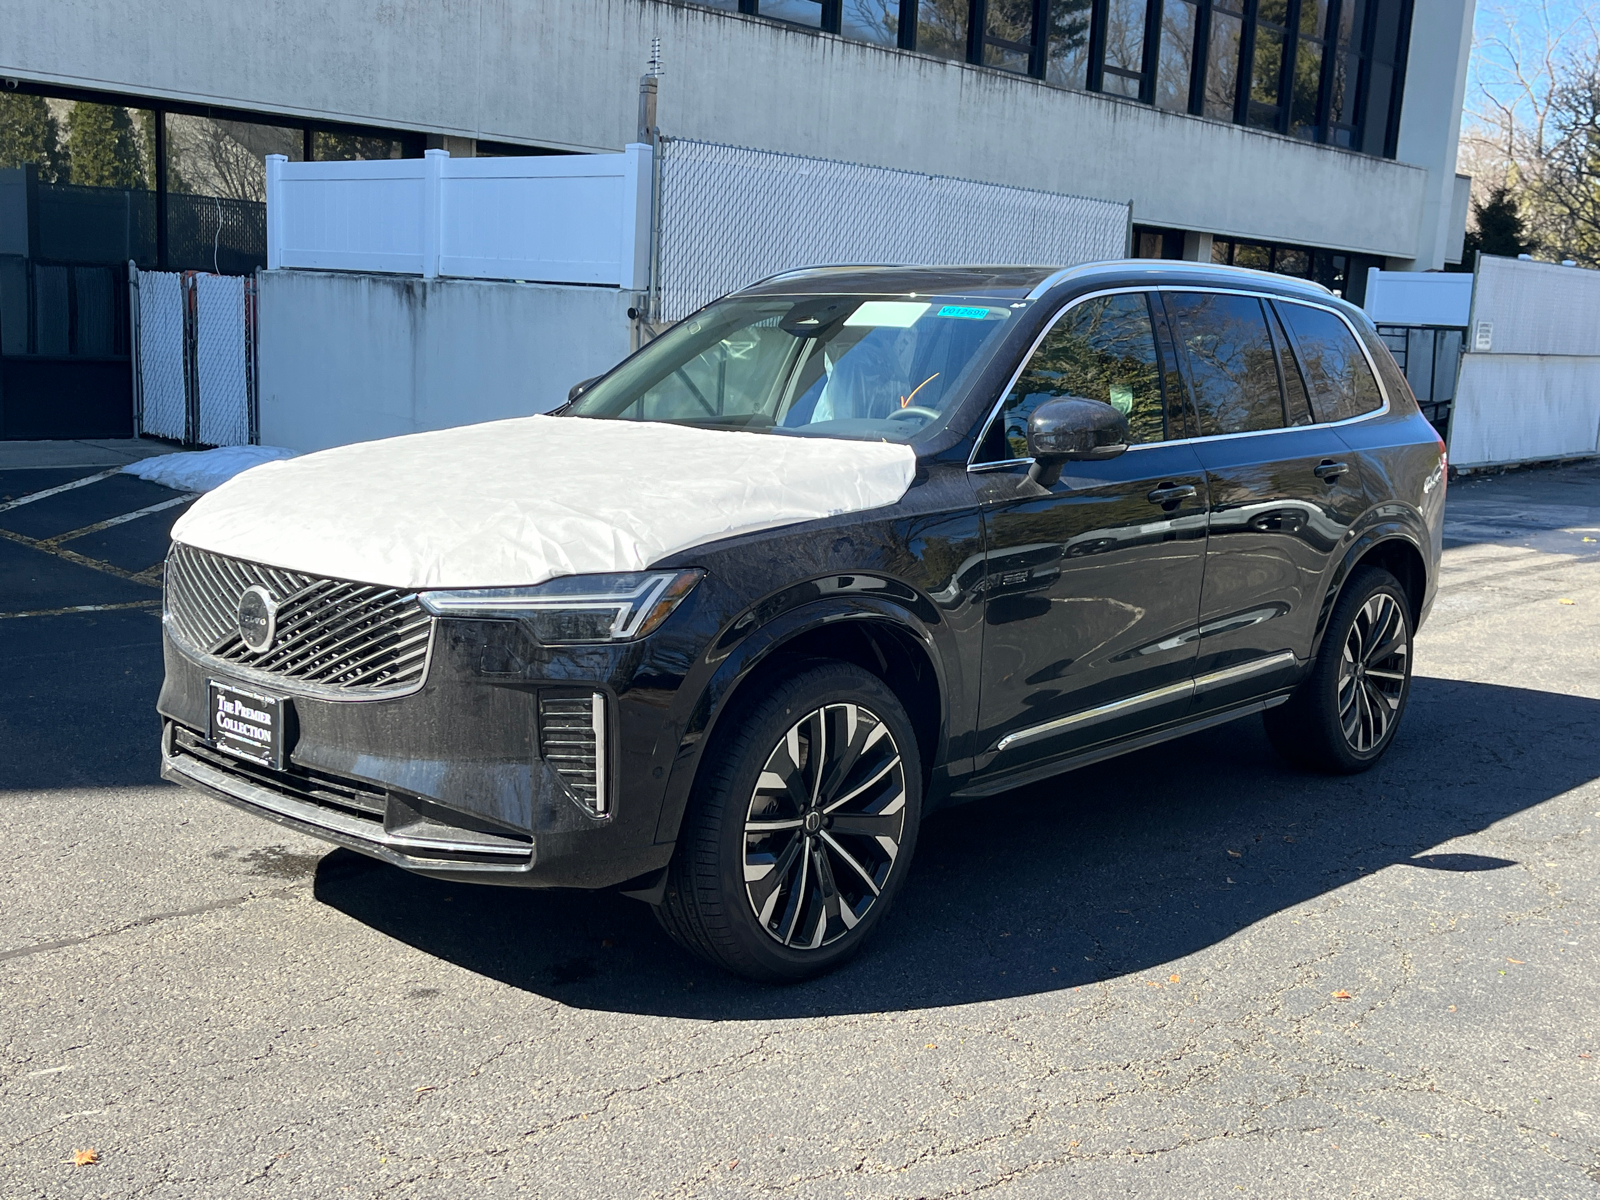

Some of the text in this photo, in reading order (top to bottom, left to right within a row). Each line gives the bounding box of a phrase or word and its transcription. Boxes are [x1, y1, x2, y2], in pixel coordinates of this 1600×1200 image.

[216, 694, 272, 725] THE PREMIER
[216, 711, 271, 742] COLLECTION
